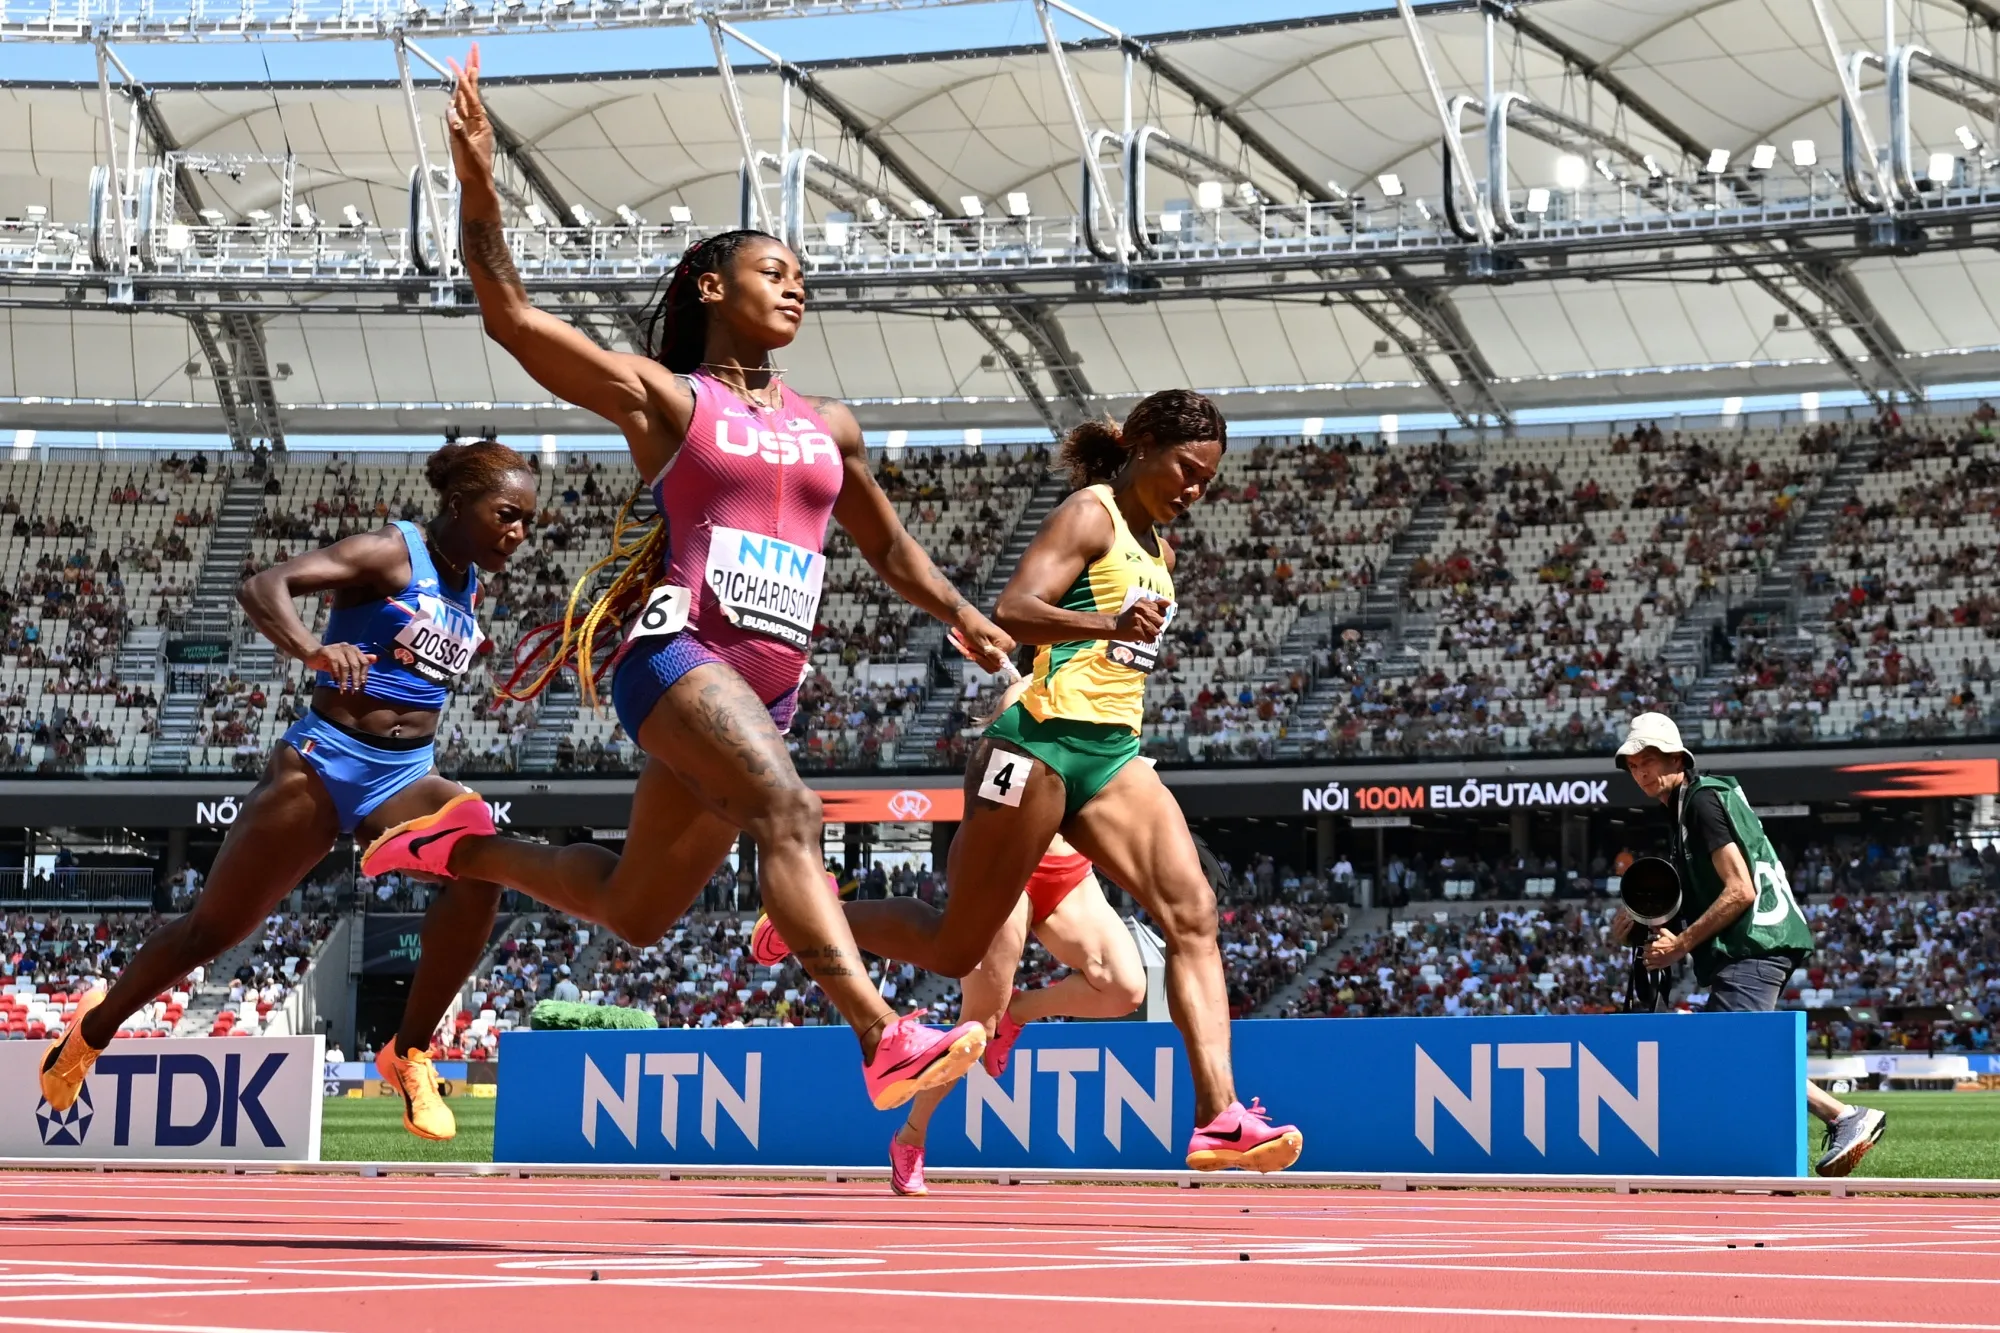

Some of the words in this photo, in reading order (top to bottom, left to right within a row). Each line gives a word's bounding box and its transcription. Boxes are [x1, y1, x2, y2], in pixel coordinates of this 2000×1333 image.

[715, 419, 841, 466] USA
[738, 534, 814, 583] NTN
[641, 593, 673, 630] 6
[712, 569, 815, 624] RICHARDSON
[433, 604, 475, 643] NTN
[742, 614, 798, 642] BUDAPEST
[409, 626, 468, 670] DOSSO
[992, 762, 1015, 796] 4
[1302, 782, 1349, 811] NŐI
[1355, 785, 1425, 810] 100M
[1430, 779, 1609, 808] ELŐFUTAMOK
[95, 1053, 289, 1148] TDK
[581, 1051, 762, 1151] NTN
[965, 1046, 1174, 1154] NTN
[1415, 1041, 1659, 1158] NTN
